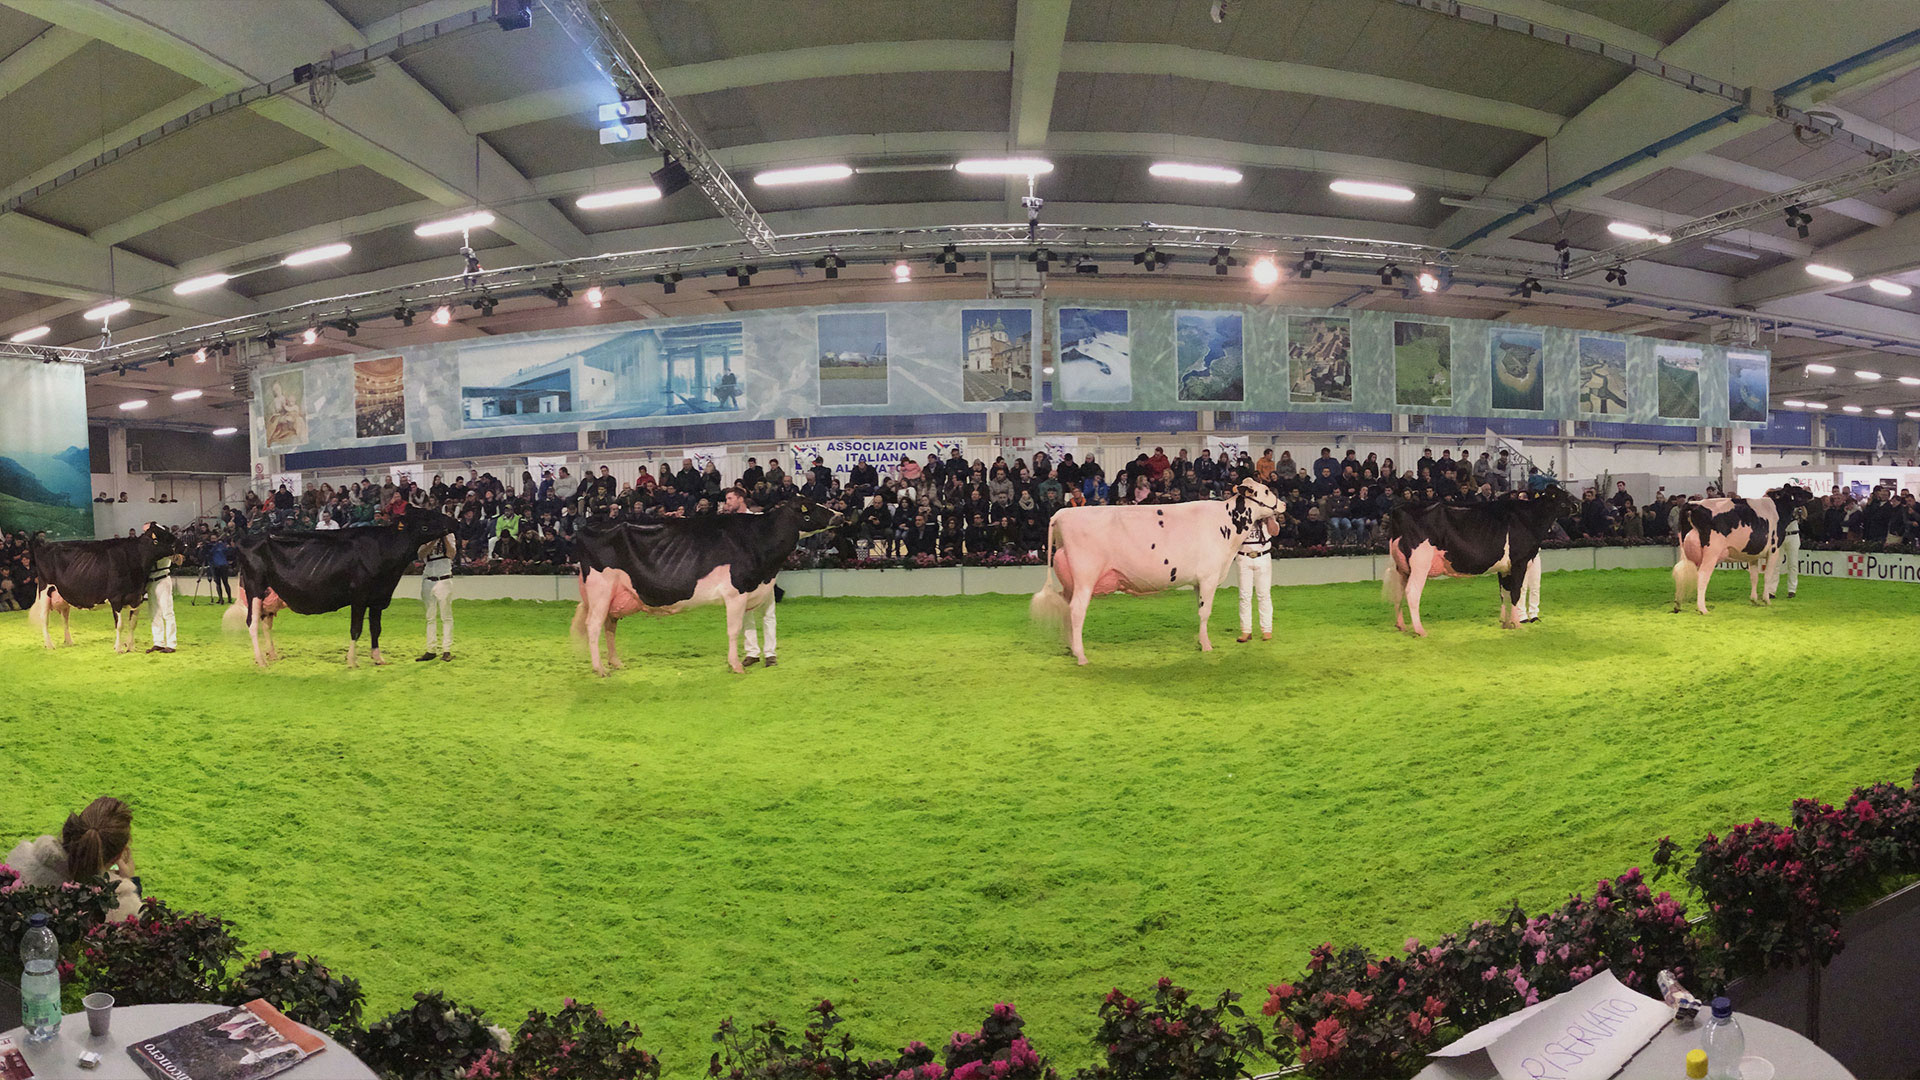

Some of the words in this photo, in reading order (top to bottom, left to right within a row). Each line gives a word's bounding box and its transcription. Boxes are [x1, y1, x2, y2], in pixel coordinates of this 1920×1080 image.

[827, 441, 928, 451] ASSOCIAZIONE
[846, 453, 907, 462] ITALIANA
[1782, 553, 1833, 576] rina
[1521, 998, 1638, 1080] RISERVATO
